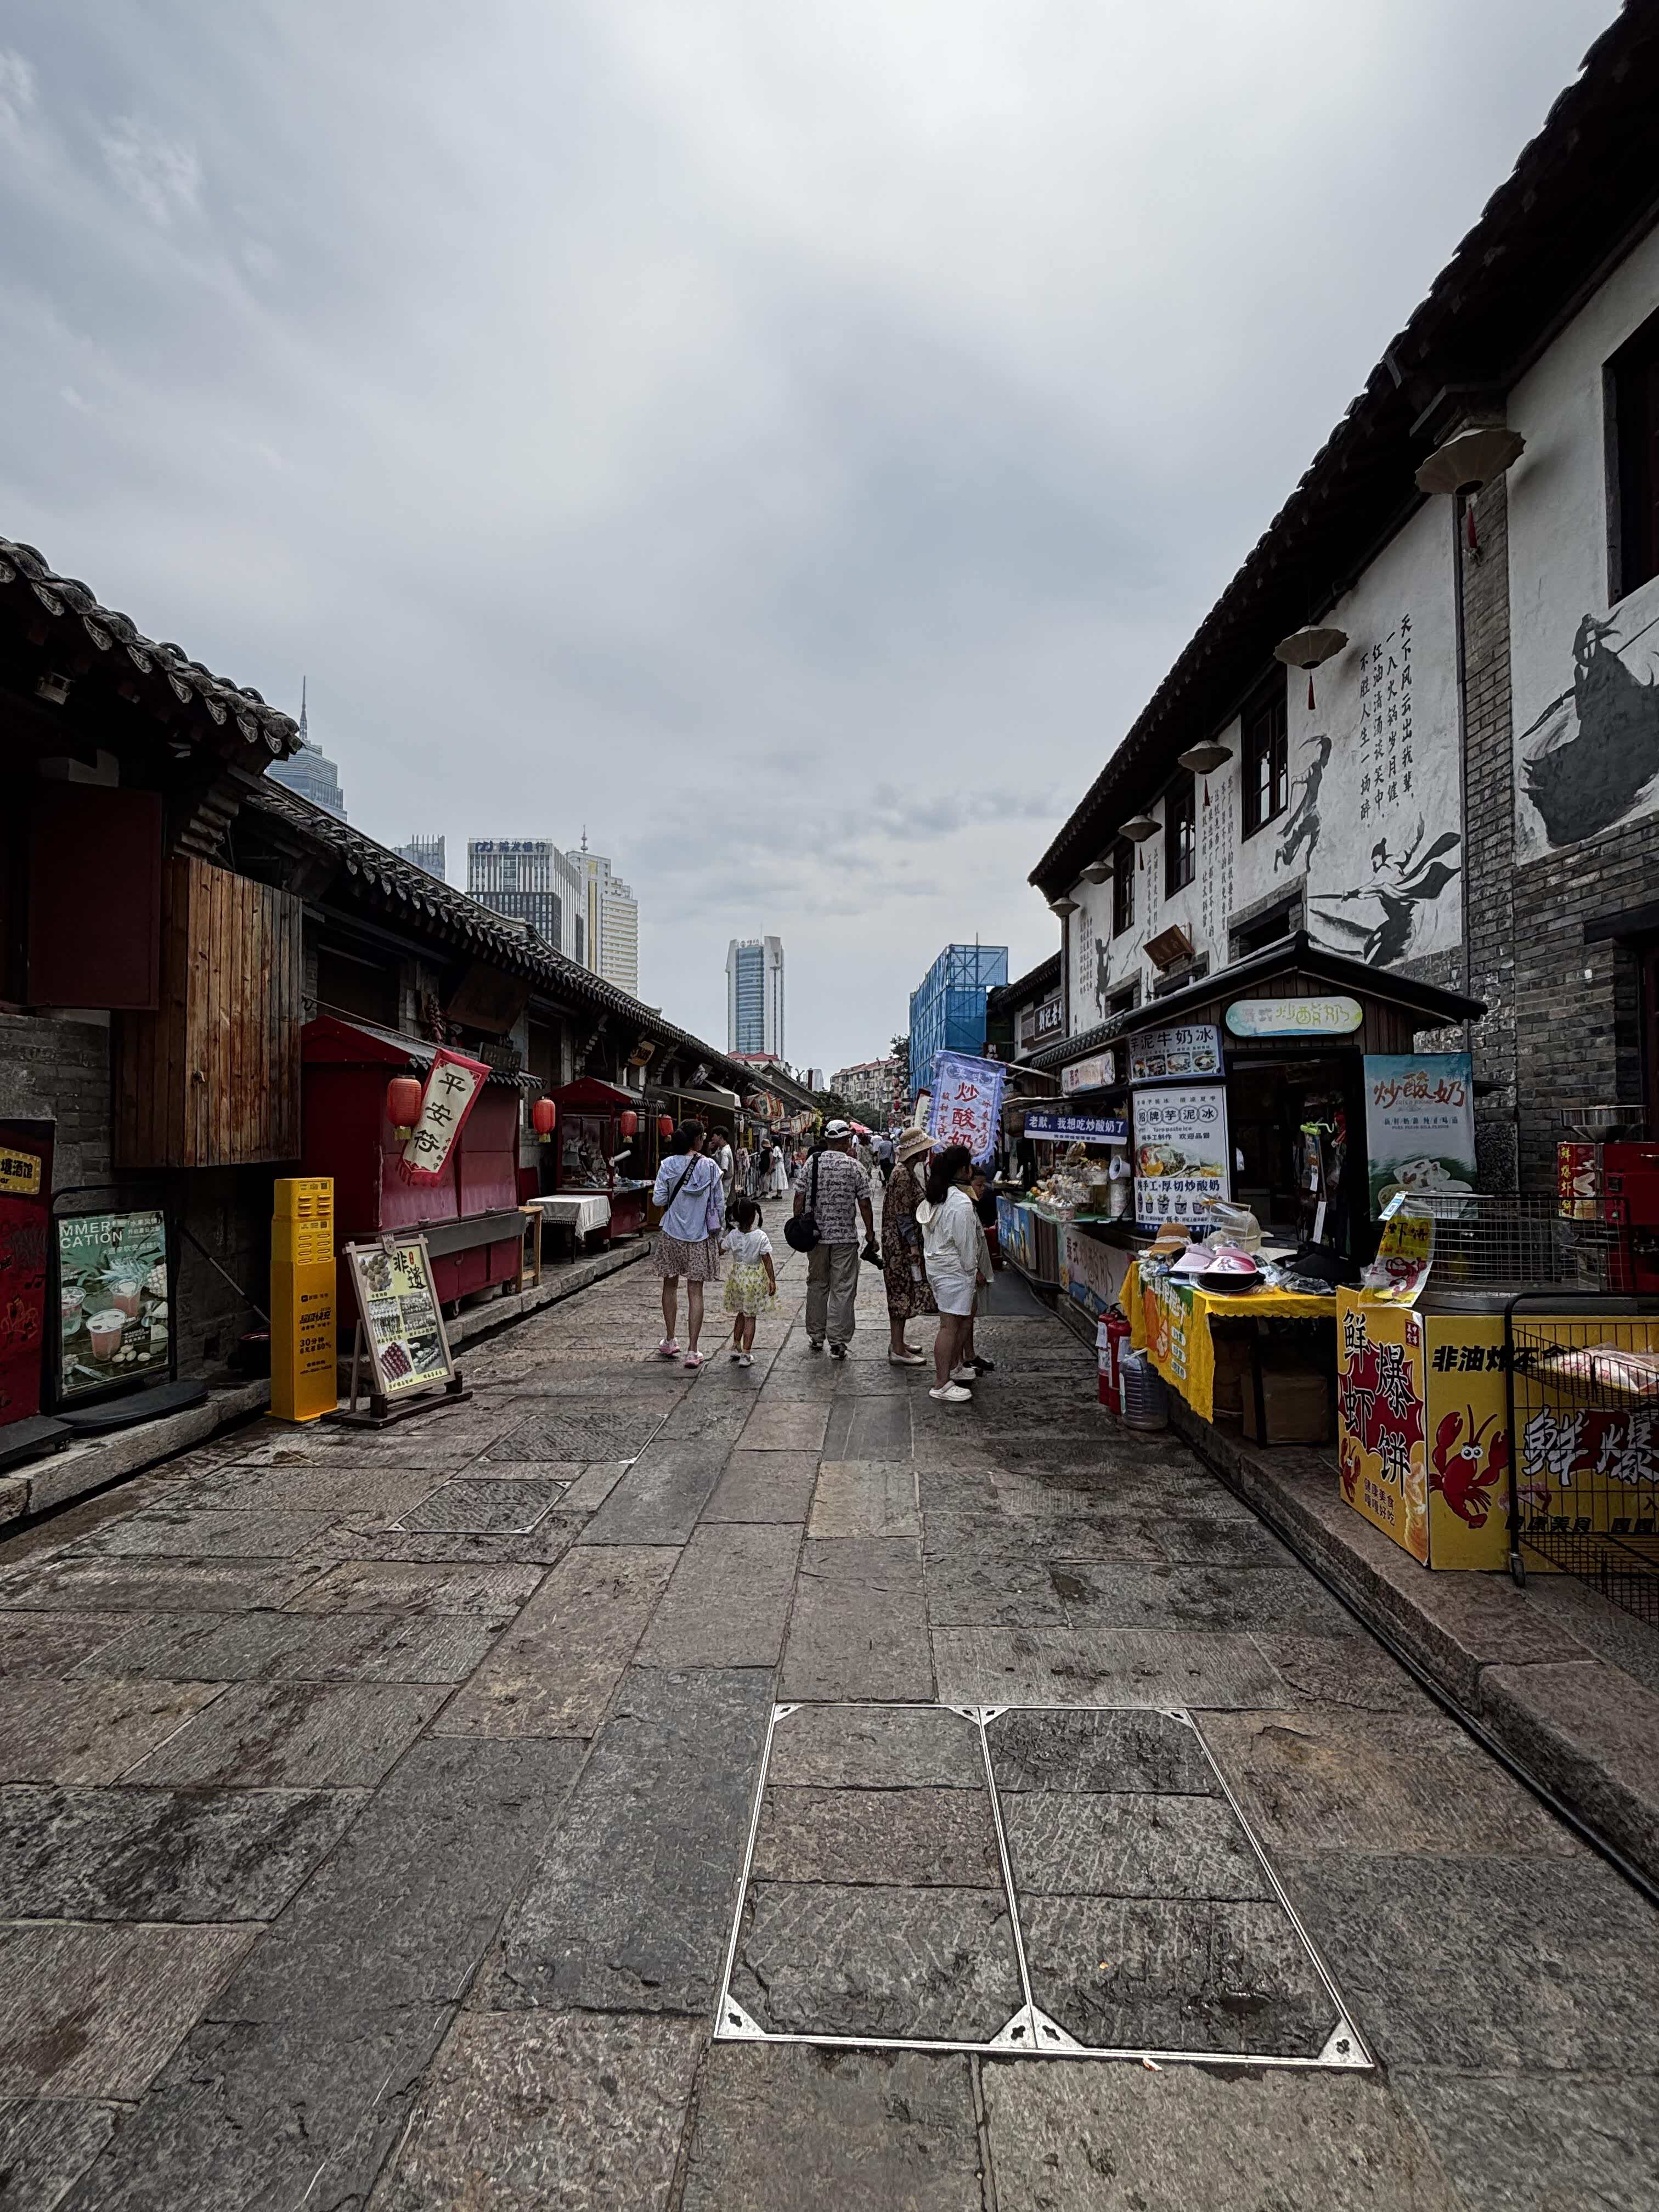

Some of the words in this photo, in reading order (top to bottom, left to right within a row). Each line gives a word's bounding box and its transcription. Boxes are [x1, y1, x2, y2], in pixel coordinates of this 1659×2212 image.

[499, 841, 546, 853] 浦发银行
[1131, 1027, 1214, 1052] 芋泥牛奶冰
[1373, 1070, 1465, 1109] 炒酸奶
[414, 1073, 466, 1153] 平安符
[948, 1082, 980, 1150] 炒酸奶
[1029, 1115, 1124, 1133] 老默，我想吃炒酸奶了
[1138, 1108, 1214, 1122] 招牌芋泥冰
[60, 1231, 123, 1249] CATION
[393, 1250, 427, 1289] 非遗
